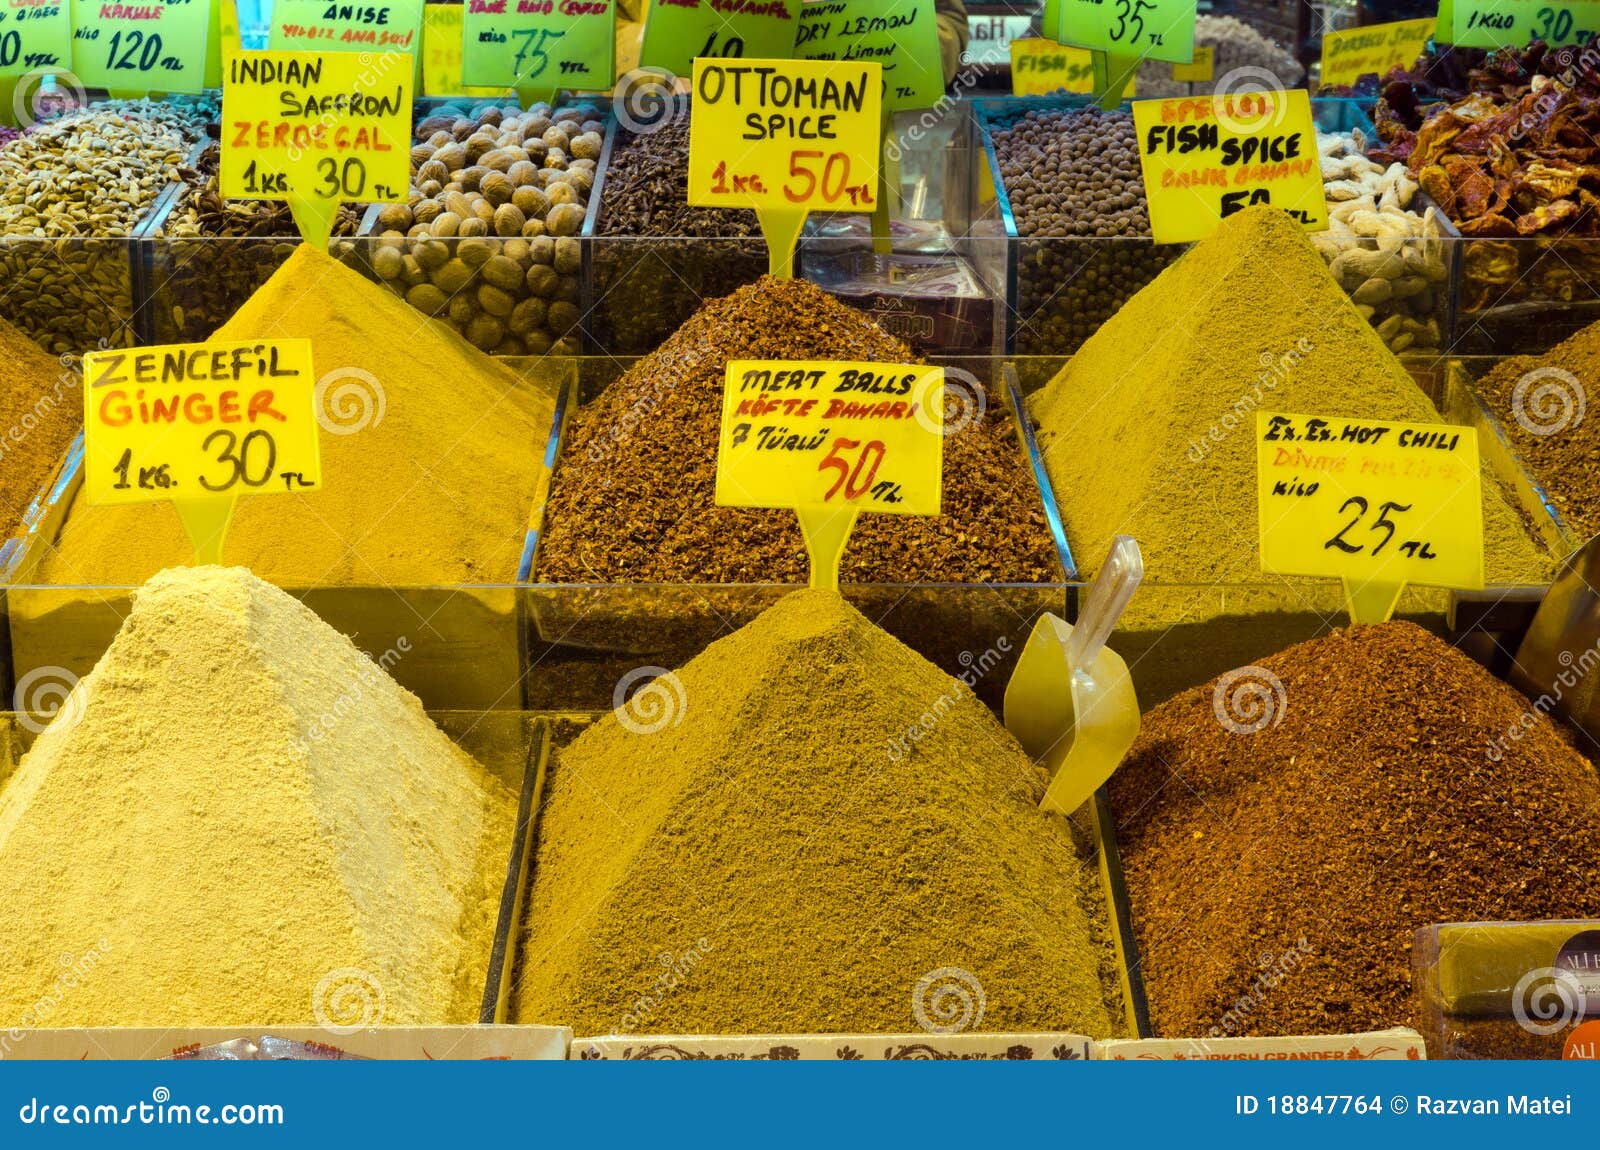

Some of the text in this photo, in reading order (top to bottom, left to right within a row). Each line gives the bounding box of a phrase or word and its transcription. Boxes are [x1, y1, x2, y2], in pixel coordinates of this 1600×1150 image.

[323, 4, 390, 25] ANISE
[794, 7, 917, 48] DRY LEMON
[1109, 0, 1157, 44] 35
[1530, 7, 1574, 42] 30
[0, 30, 21, 66] 0
[106, 30, 163, 71] 120
[511, 28, 565, 78] 75
[231, 57, 322, 88] INDIAN
[699, 65, 868, 112] OTTOMAN
[280, 85, 402, 117] SAFFRON
[742, 112, 837, 140] SPICE
[1147, 122, 1302, 166] FISH SPICE
[314, 157, 366, 199] 30
[374, 184, 399, 199] TL
[783, 150, 851, 203] 50
[845, 183, 875, 205] TL
[740, 370, 916, 395] MEAT BALLS
[198, 429, 276, 492] 30
[280, 471, 315, 490] TL
[1398, 429, 1460, 451] CHILI
[817, 437, 887, 503] 50
[1324, 496, 1436, 559] 25 TL
